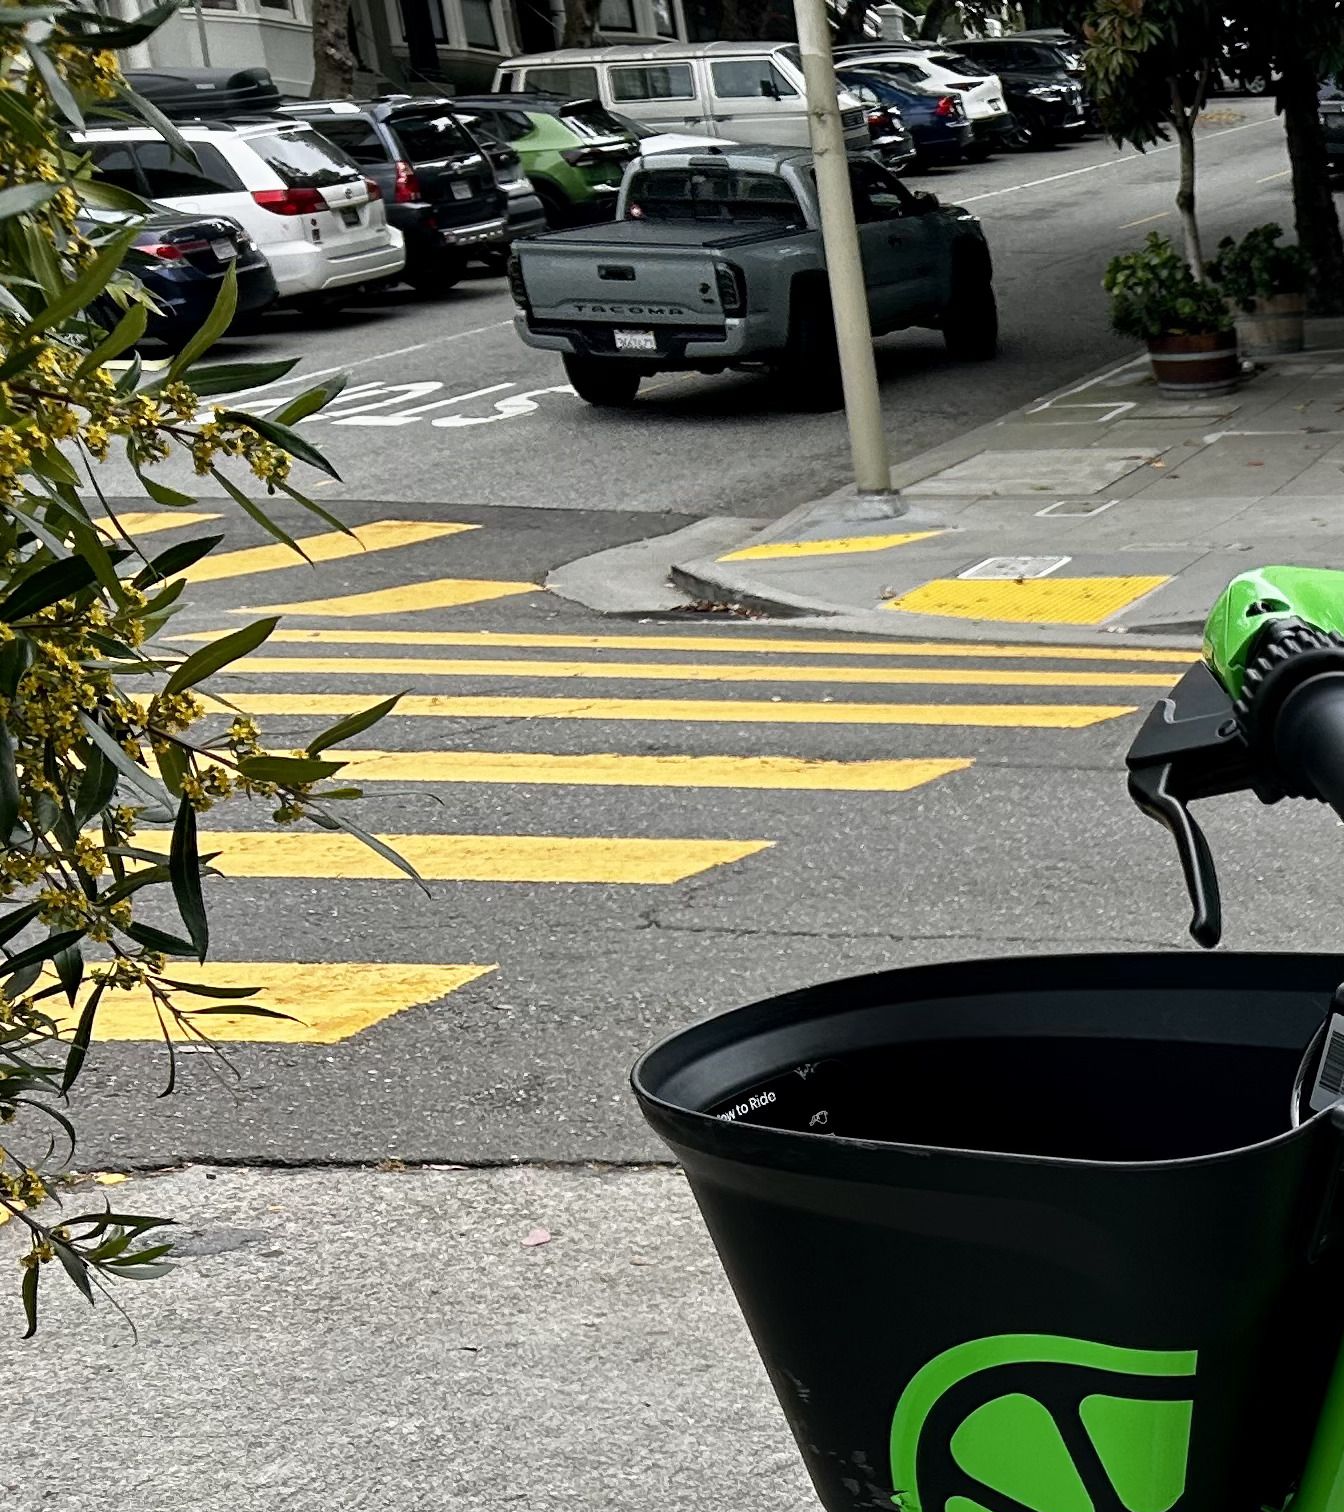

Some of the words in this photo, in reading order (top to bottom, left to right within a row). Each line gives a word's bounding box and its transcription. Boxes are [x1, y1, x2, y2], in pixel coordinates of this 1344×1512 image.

[573, 304, 685, 316] TACOMA
[735, 1103, 749, 1116] to
[748, 1091, 777, 1111] Ride
